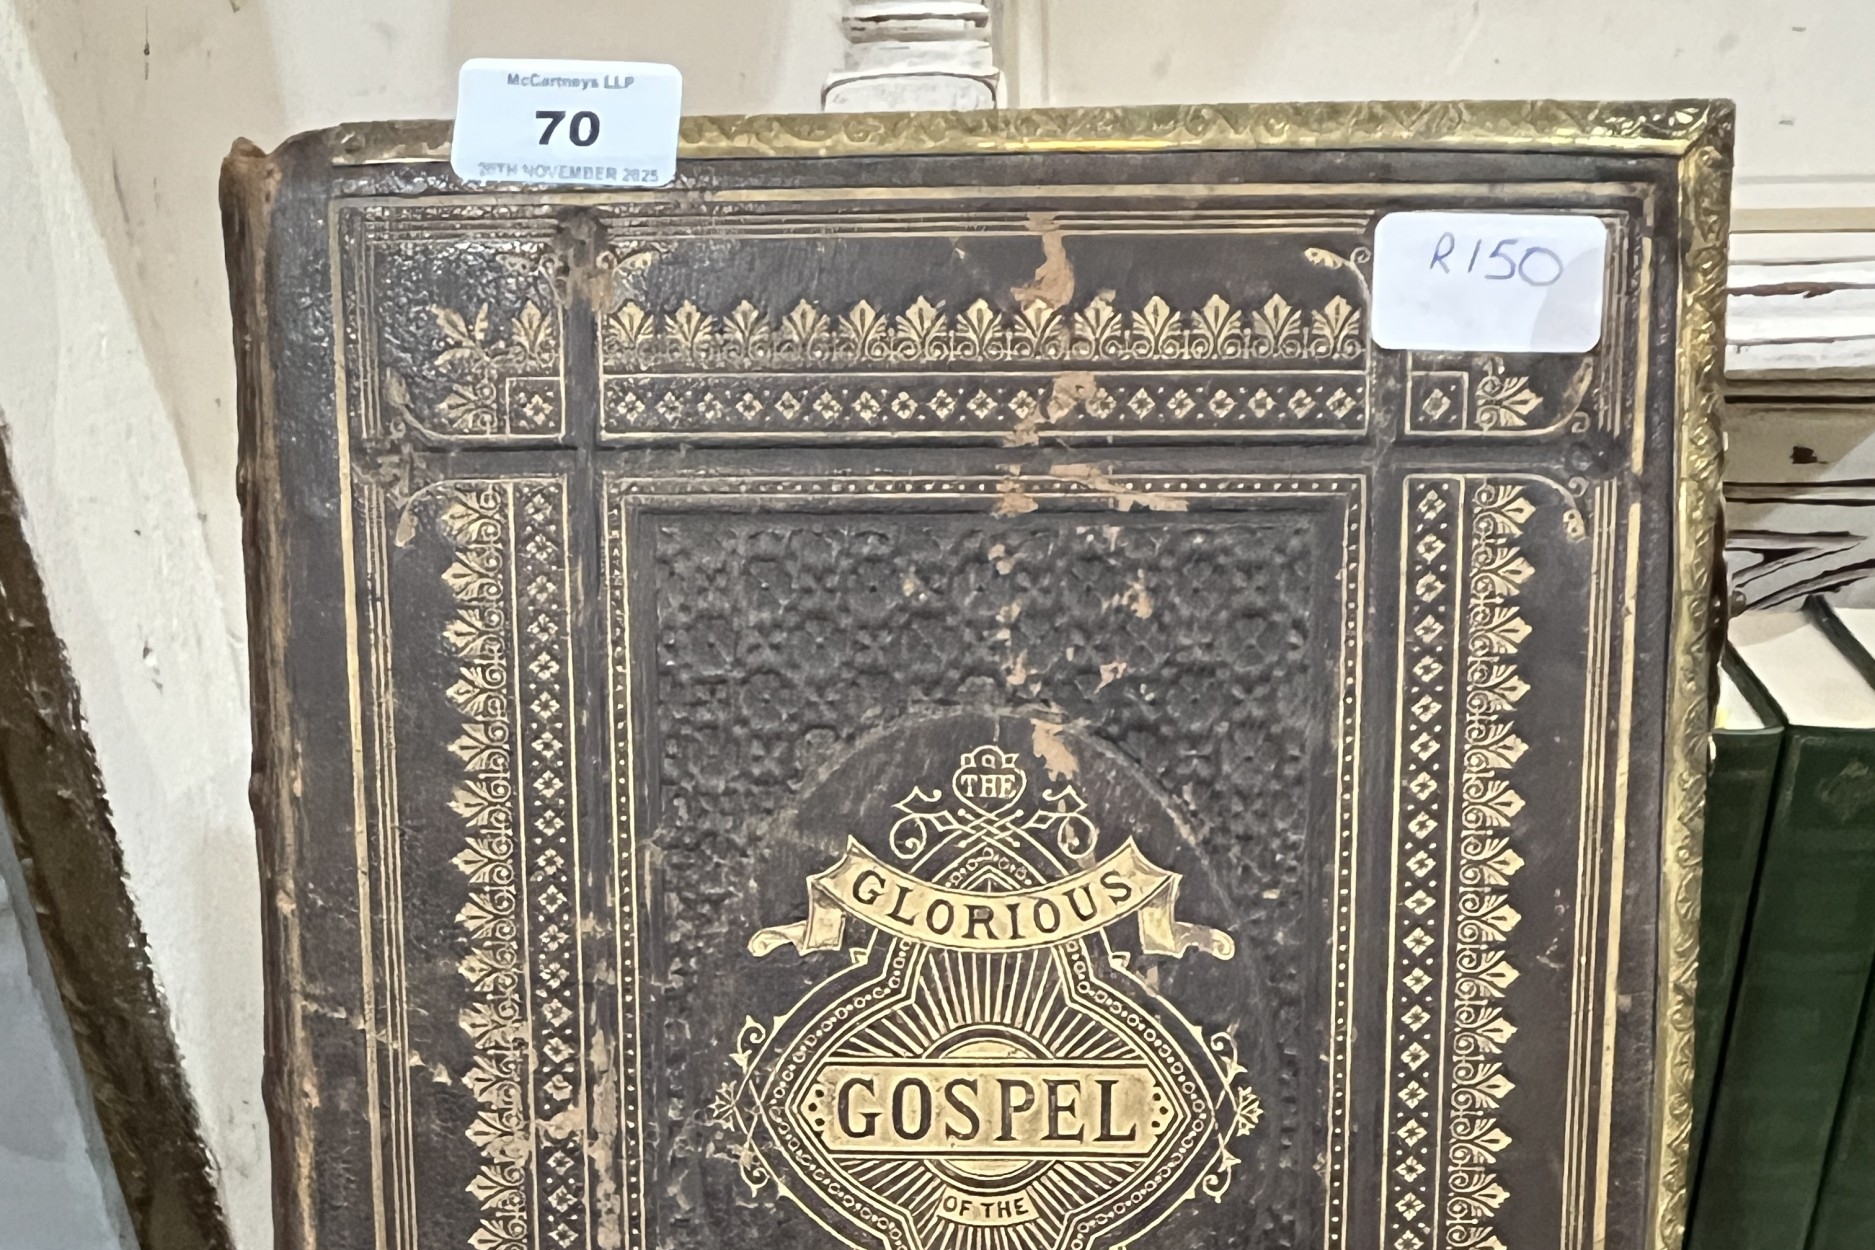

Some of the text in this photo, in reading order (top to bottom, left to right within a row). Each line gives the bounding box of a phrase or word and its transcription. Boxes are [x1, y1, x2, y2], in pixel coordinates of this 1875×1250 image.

[507, 73, 635, 89] McCartneys LLP
[535, 110, 600, 147] 70
[522, 164, 617, 181] NOVEMBER
[622, 168, 659, 182] 2025
[1429, 231, 1563, 287] R150
[960, 774, 1017, 800] THE
[852, 869, 1132, 940] GLORIOUS
[837, 1077, 1137, 1141] GOSPEL
[942, 1195, 1029, 1218] OF THE
